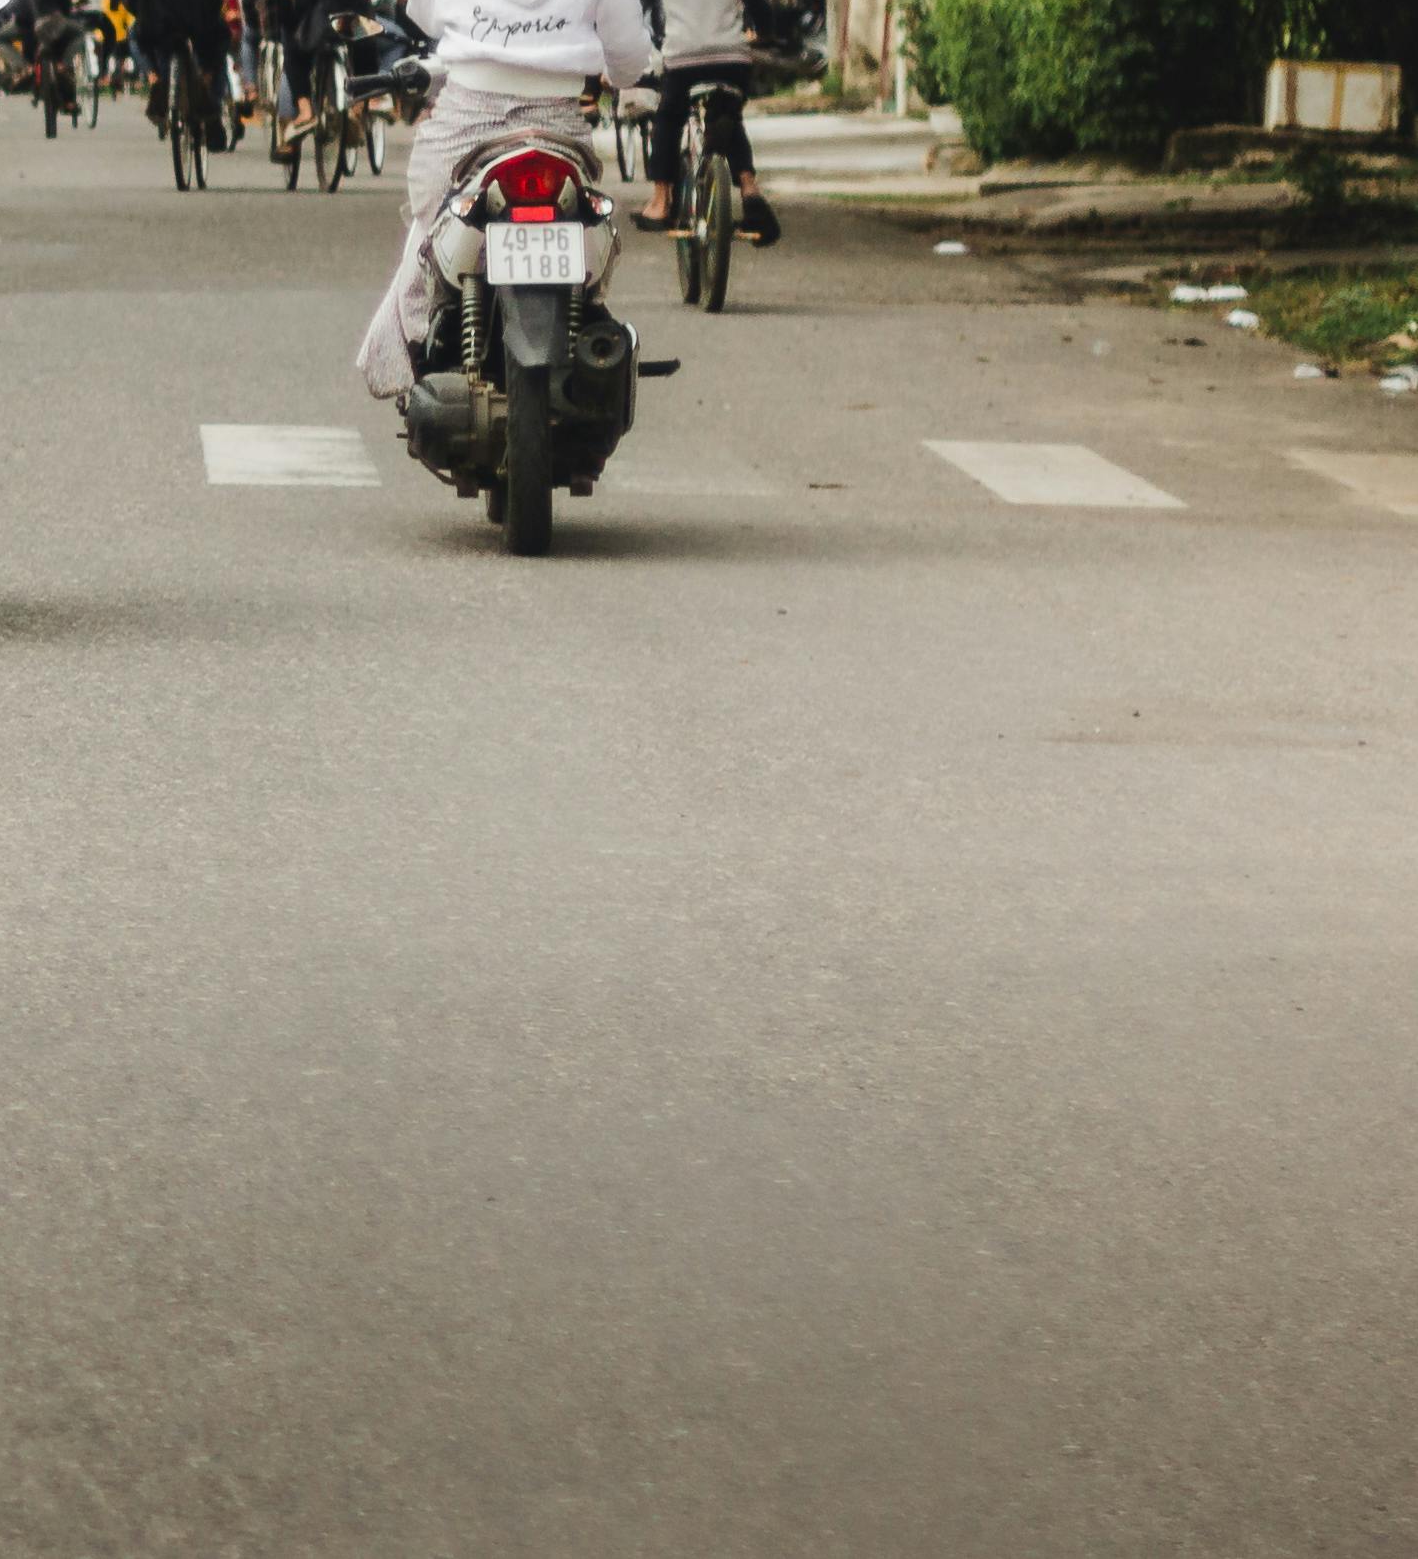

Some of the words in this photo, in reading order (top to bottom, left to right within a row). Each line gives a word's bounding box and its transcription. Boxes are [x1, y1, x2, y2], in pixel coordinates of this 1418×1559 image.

[470, 5, 571, 48] Emporio
[502, 227, 569, 251] 49-P6
[504, 254, 570, 279] 1188
